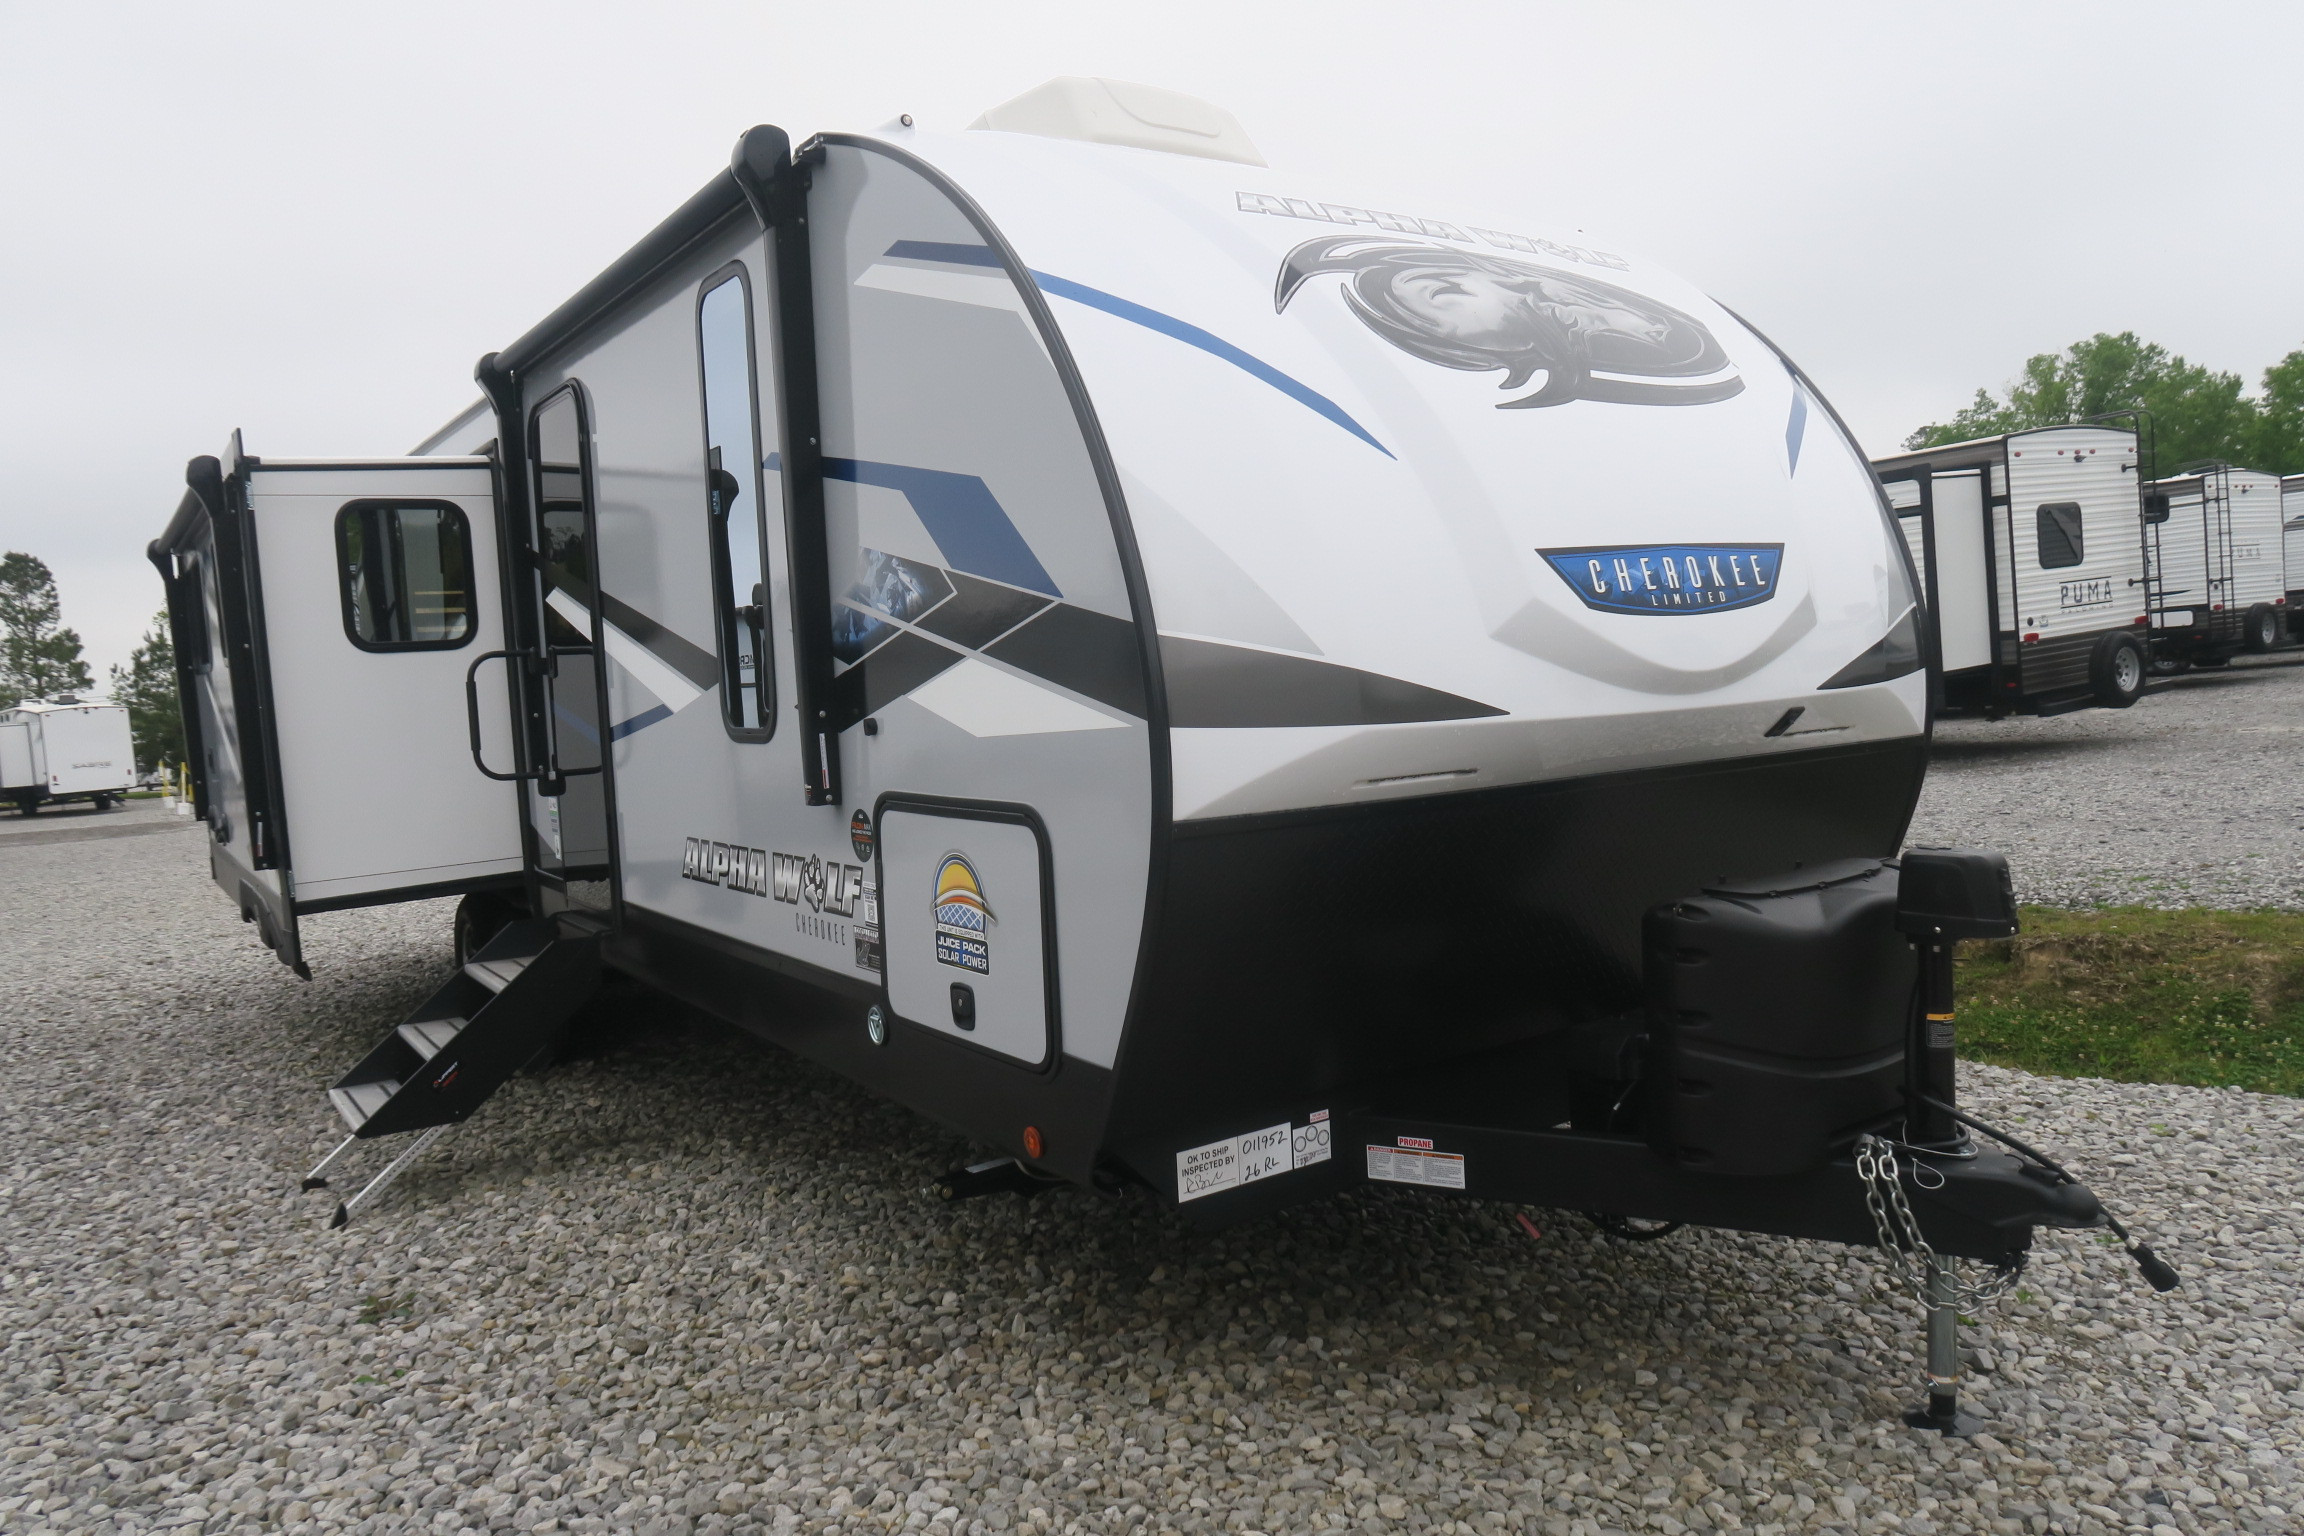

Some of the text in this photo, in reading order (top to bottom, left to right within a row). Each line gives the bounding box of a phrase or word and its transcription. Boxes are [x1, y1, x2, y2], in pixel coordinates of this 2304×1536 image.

[1235, 190, 1476, 244] ALPHA
[1588, 555, 1766, 593] CHEROKEE
[1651, 591, 1727, 606] LIMITED
[2060, 580, 2112, 605] PUMA
[682, 837, 767, 898] ALPHA
[795, 912, 846, 946] CHEROKEE
[938, 936, 986, 956] JUICE PACK
[938, 948, 987, 970] SOLAR POWER
[1242, 1130, 1288, 1155] 011952
[1399, 1137, 1432, 1149] PROPANE
[1187, 1145, 1229, 1164] OK TO SHIP
[1181, 1155, 1235, 1177] INSPECTED BY
[1244, 1163, 1261, 1182] 26
